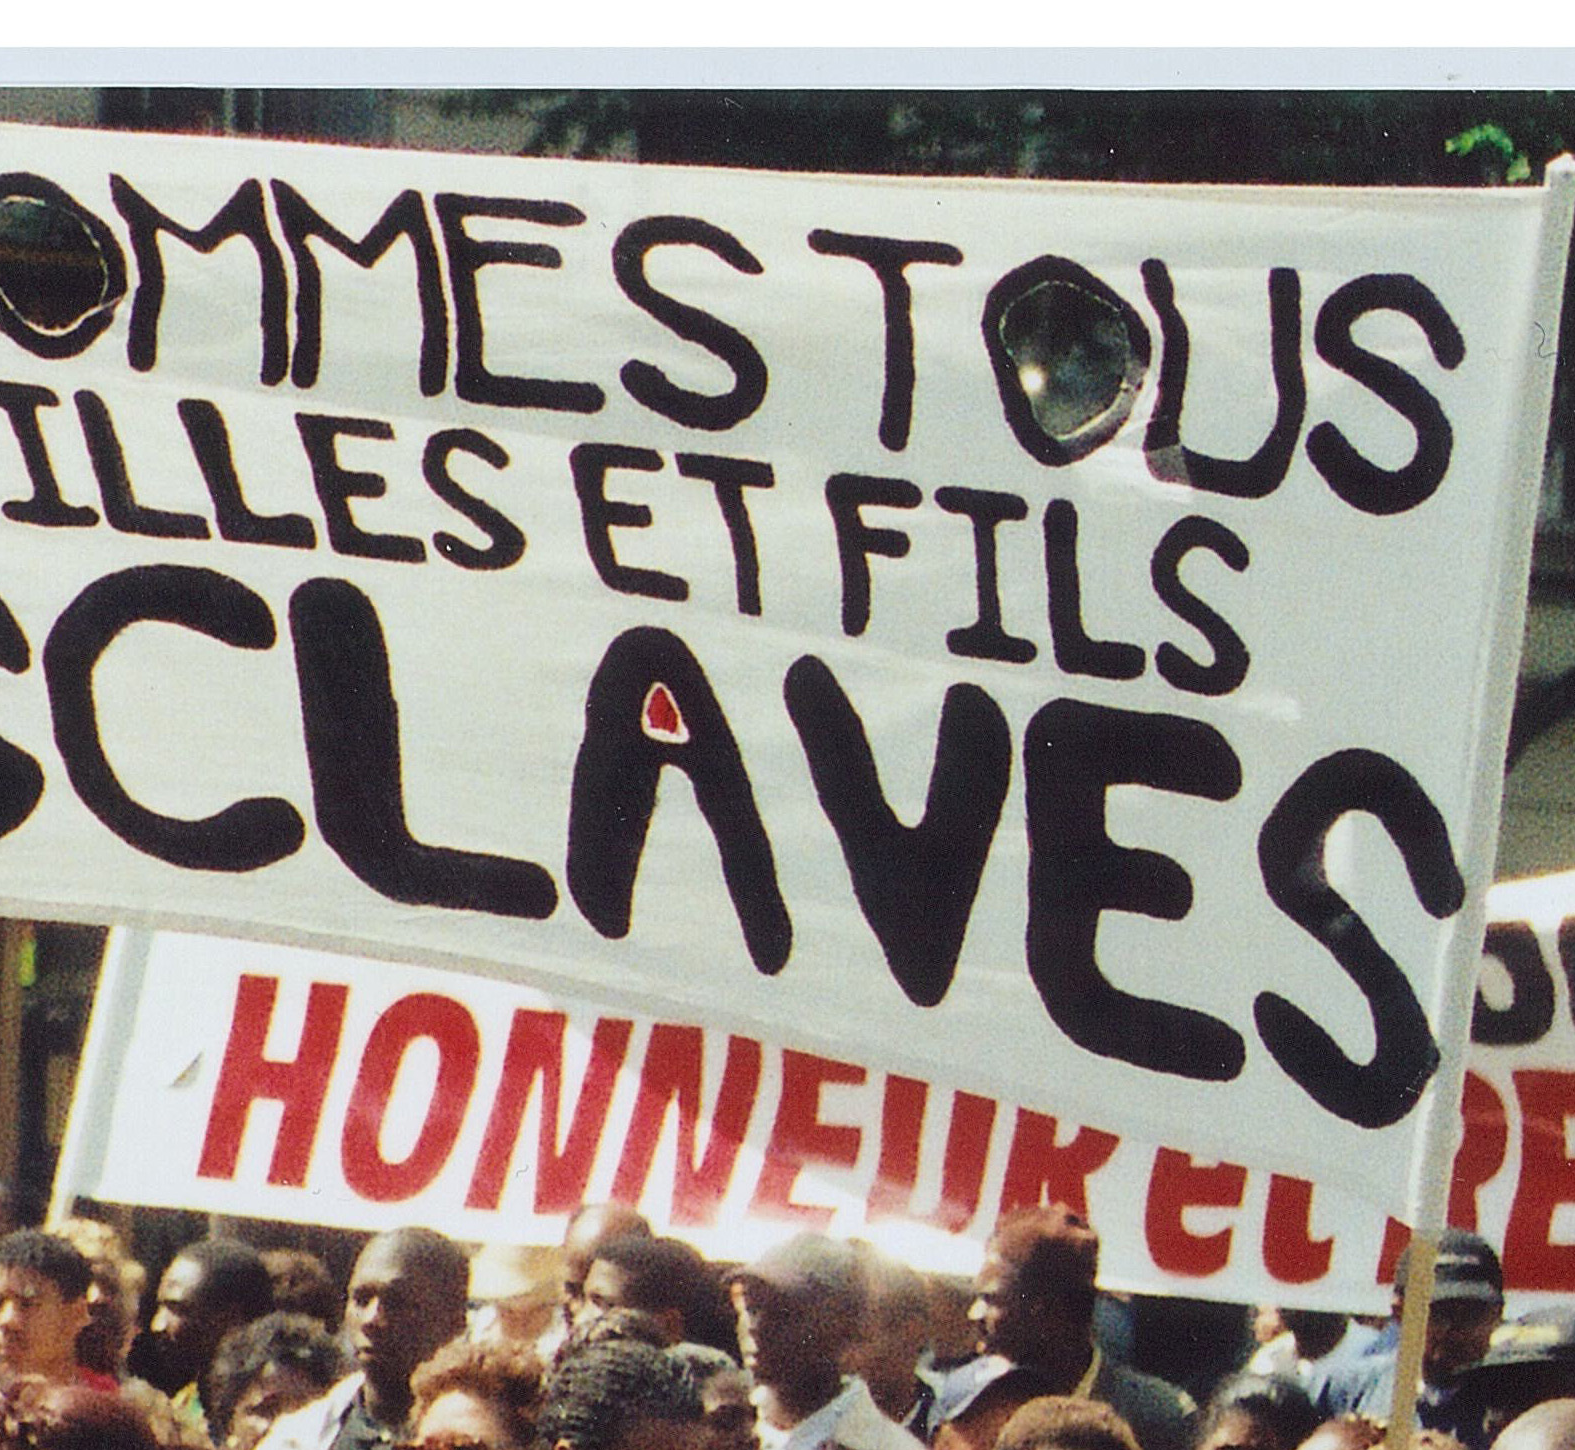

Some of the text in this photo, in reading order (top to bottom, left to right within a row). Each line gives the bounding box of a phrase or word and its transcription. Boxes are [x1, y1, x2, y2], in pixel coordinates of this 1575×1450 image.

[806, 228, 1467, 516] TOUS
[567, 443, 776, 616] ET
[824, 473, 1252, 697] FILS
